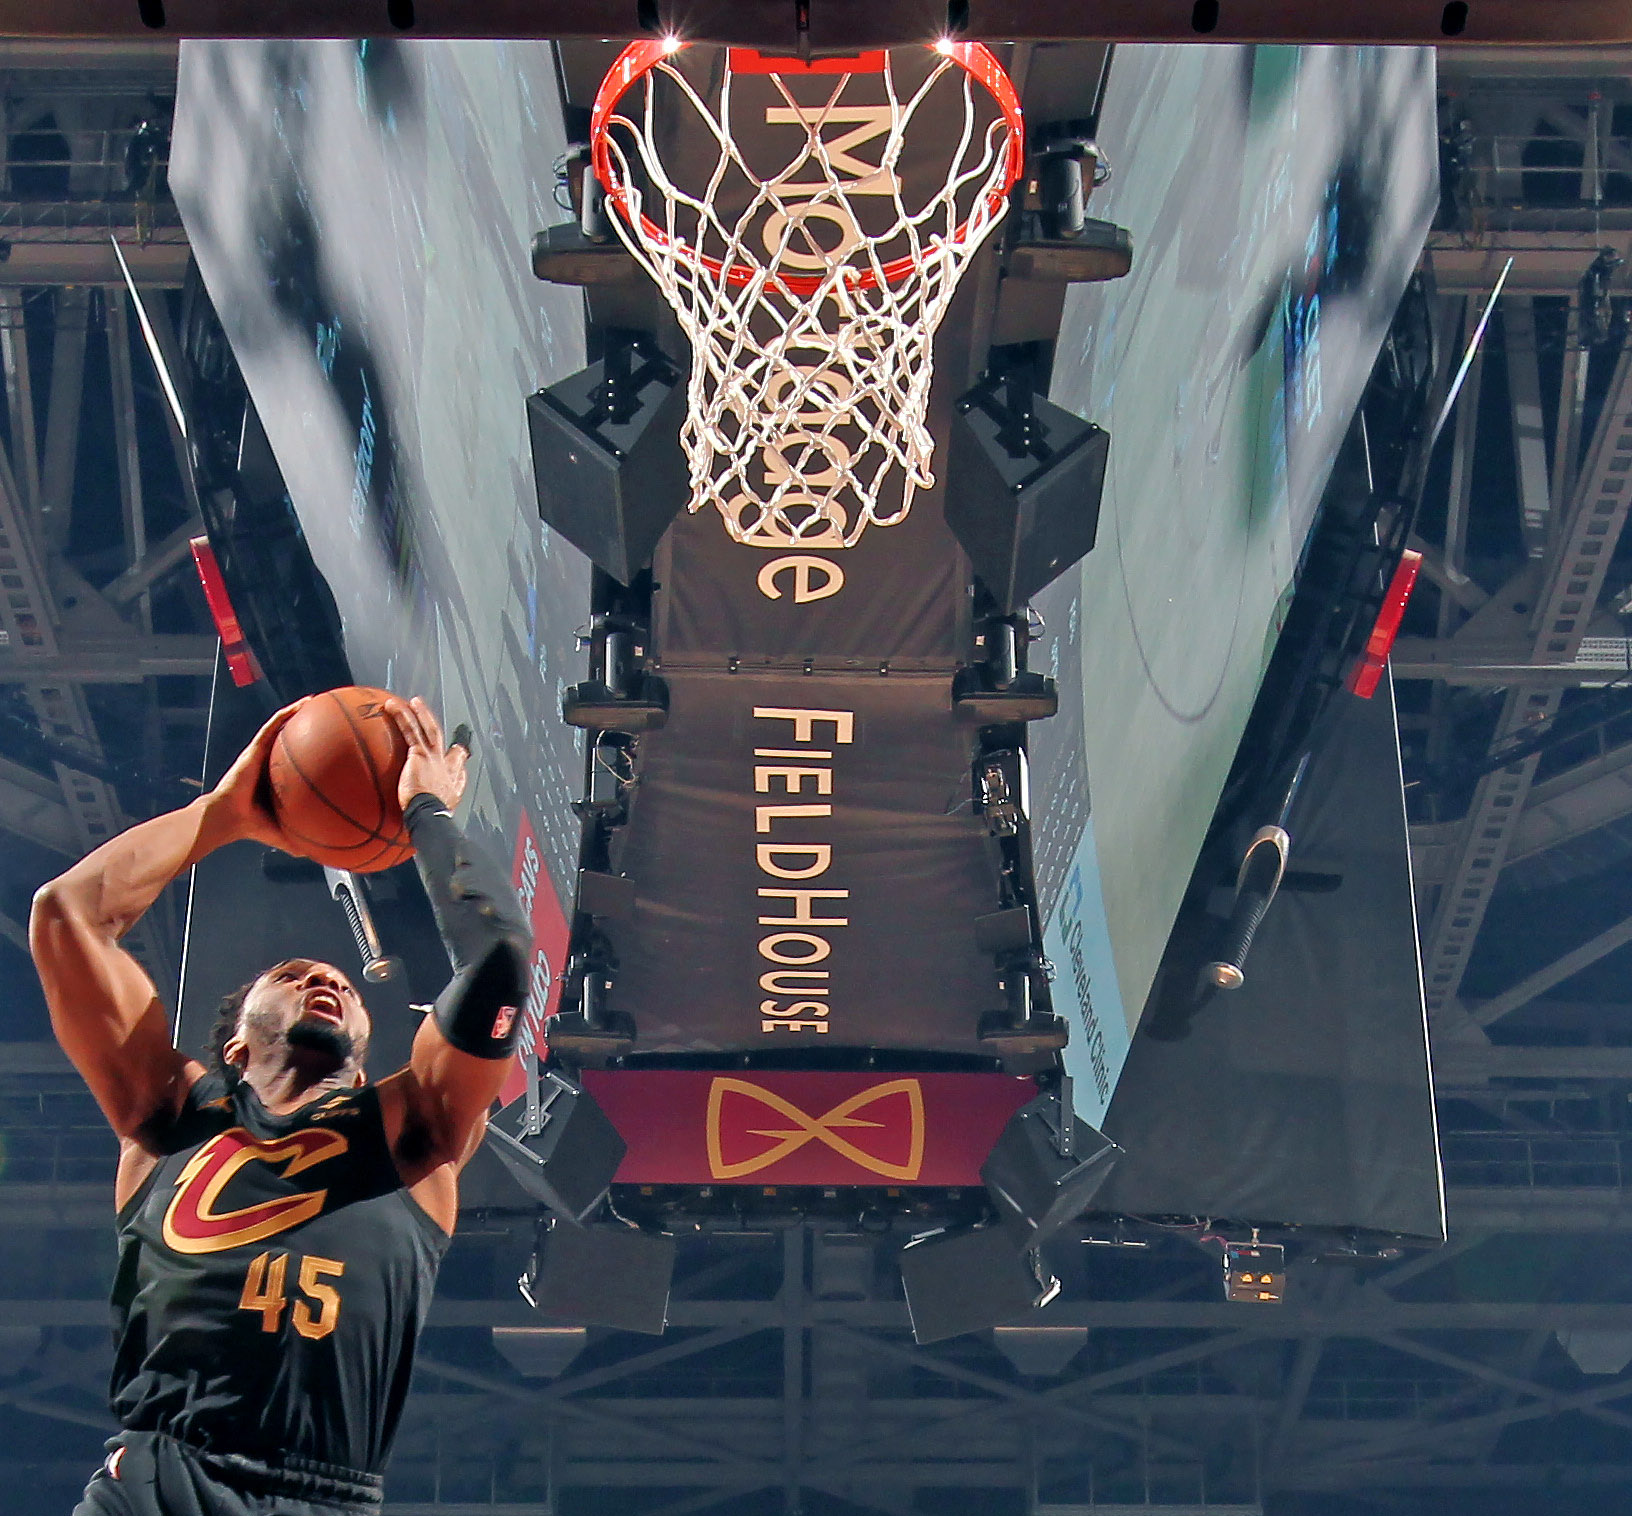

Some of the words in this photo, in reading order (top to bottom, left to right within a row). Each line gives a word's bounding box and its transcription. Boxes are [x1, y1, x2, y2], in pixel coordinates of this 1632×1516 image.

[730, 105, 908, 604] Motgage
[753, 706, 855, 1034] FIELDHOUSE
[1068, 918, 1099, 1045] Cleveland
[1089, 1029, 1110, 1106] Clinic
[238, 1251, 345, 1340] 45
